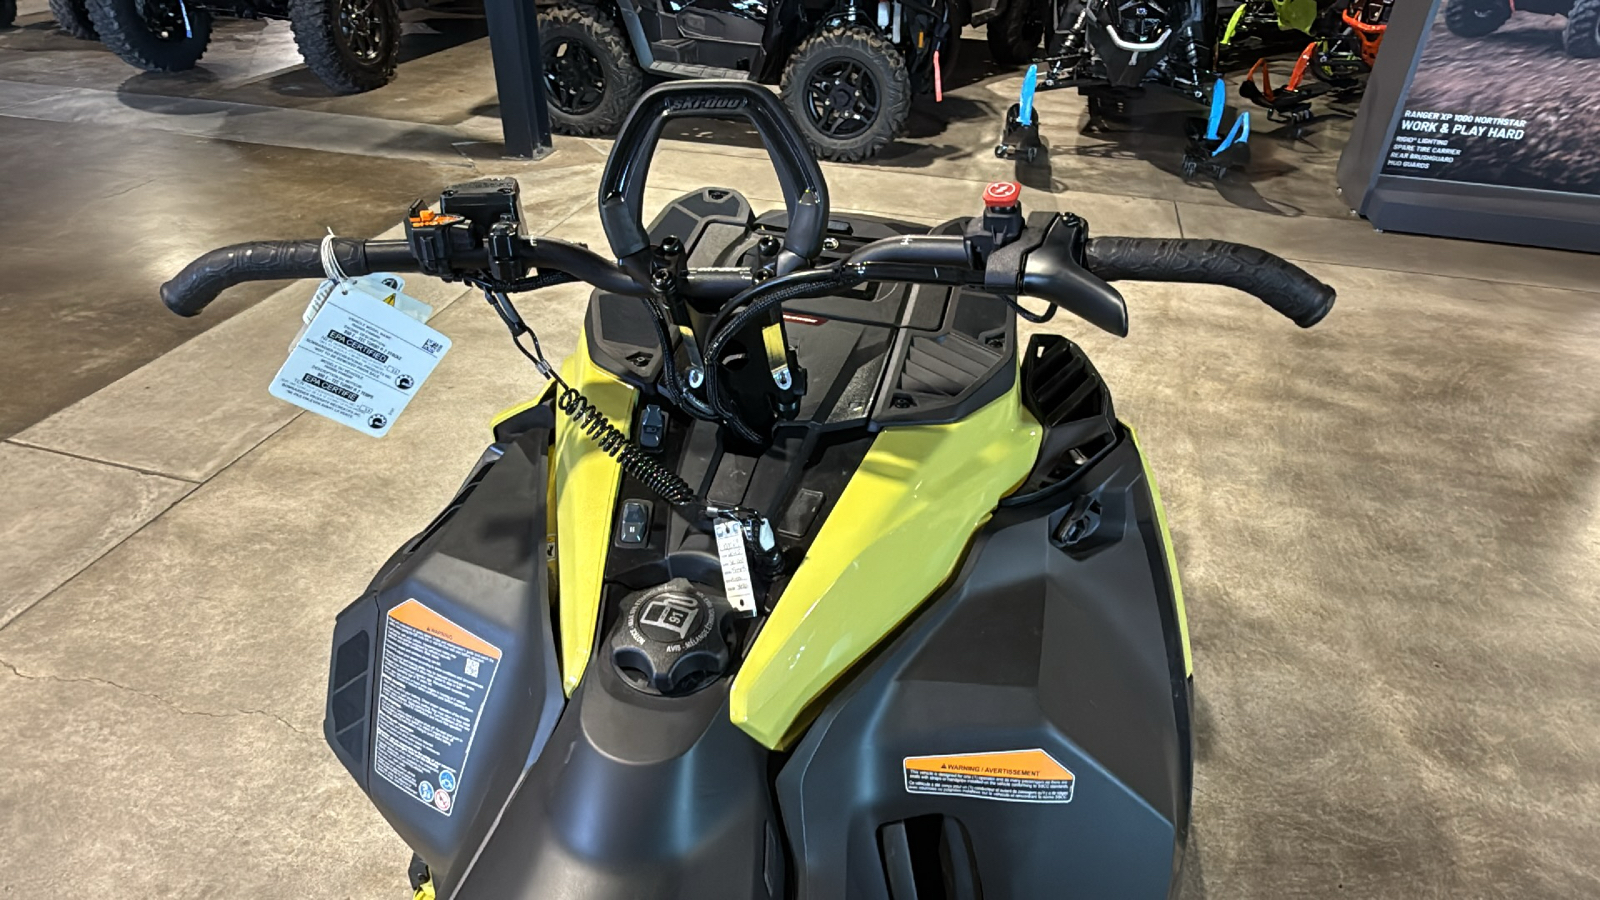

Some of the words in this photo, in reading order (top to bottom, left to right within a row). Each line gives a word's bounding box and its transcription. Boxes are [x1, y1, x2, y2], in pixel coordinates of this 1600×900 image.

[1404, 110, 1440, 120] RANGER
[1440, 112, 1453, 121] XP
[1453, 114, 1474, 123] 1000
[1474, 116, 1527, 128] NORTHSTAR
[1401, 120, 1439, 132] WORK
[1440, 123, 1449, 133] &
[1452, 124, 1487, 136] PLAY
[1487, 127, 1525, 140] HARD
[1431, 147, 1461, 155] CARRIER
[1409, 153, 1454, 163] BRUSHGUARD
[1402, 161, 1430, 169] GUARDS
[329, 331, 348, 344] EPA
[345, 339, 387, 363] CERTIFIED
[304, 375, 323, 387] EPA
[668, 611, 685, 625] 91
[947, 764, 980, 773] WARNING
[984, 766, 1040, 777] AVERTISSEMENT
